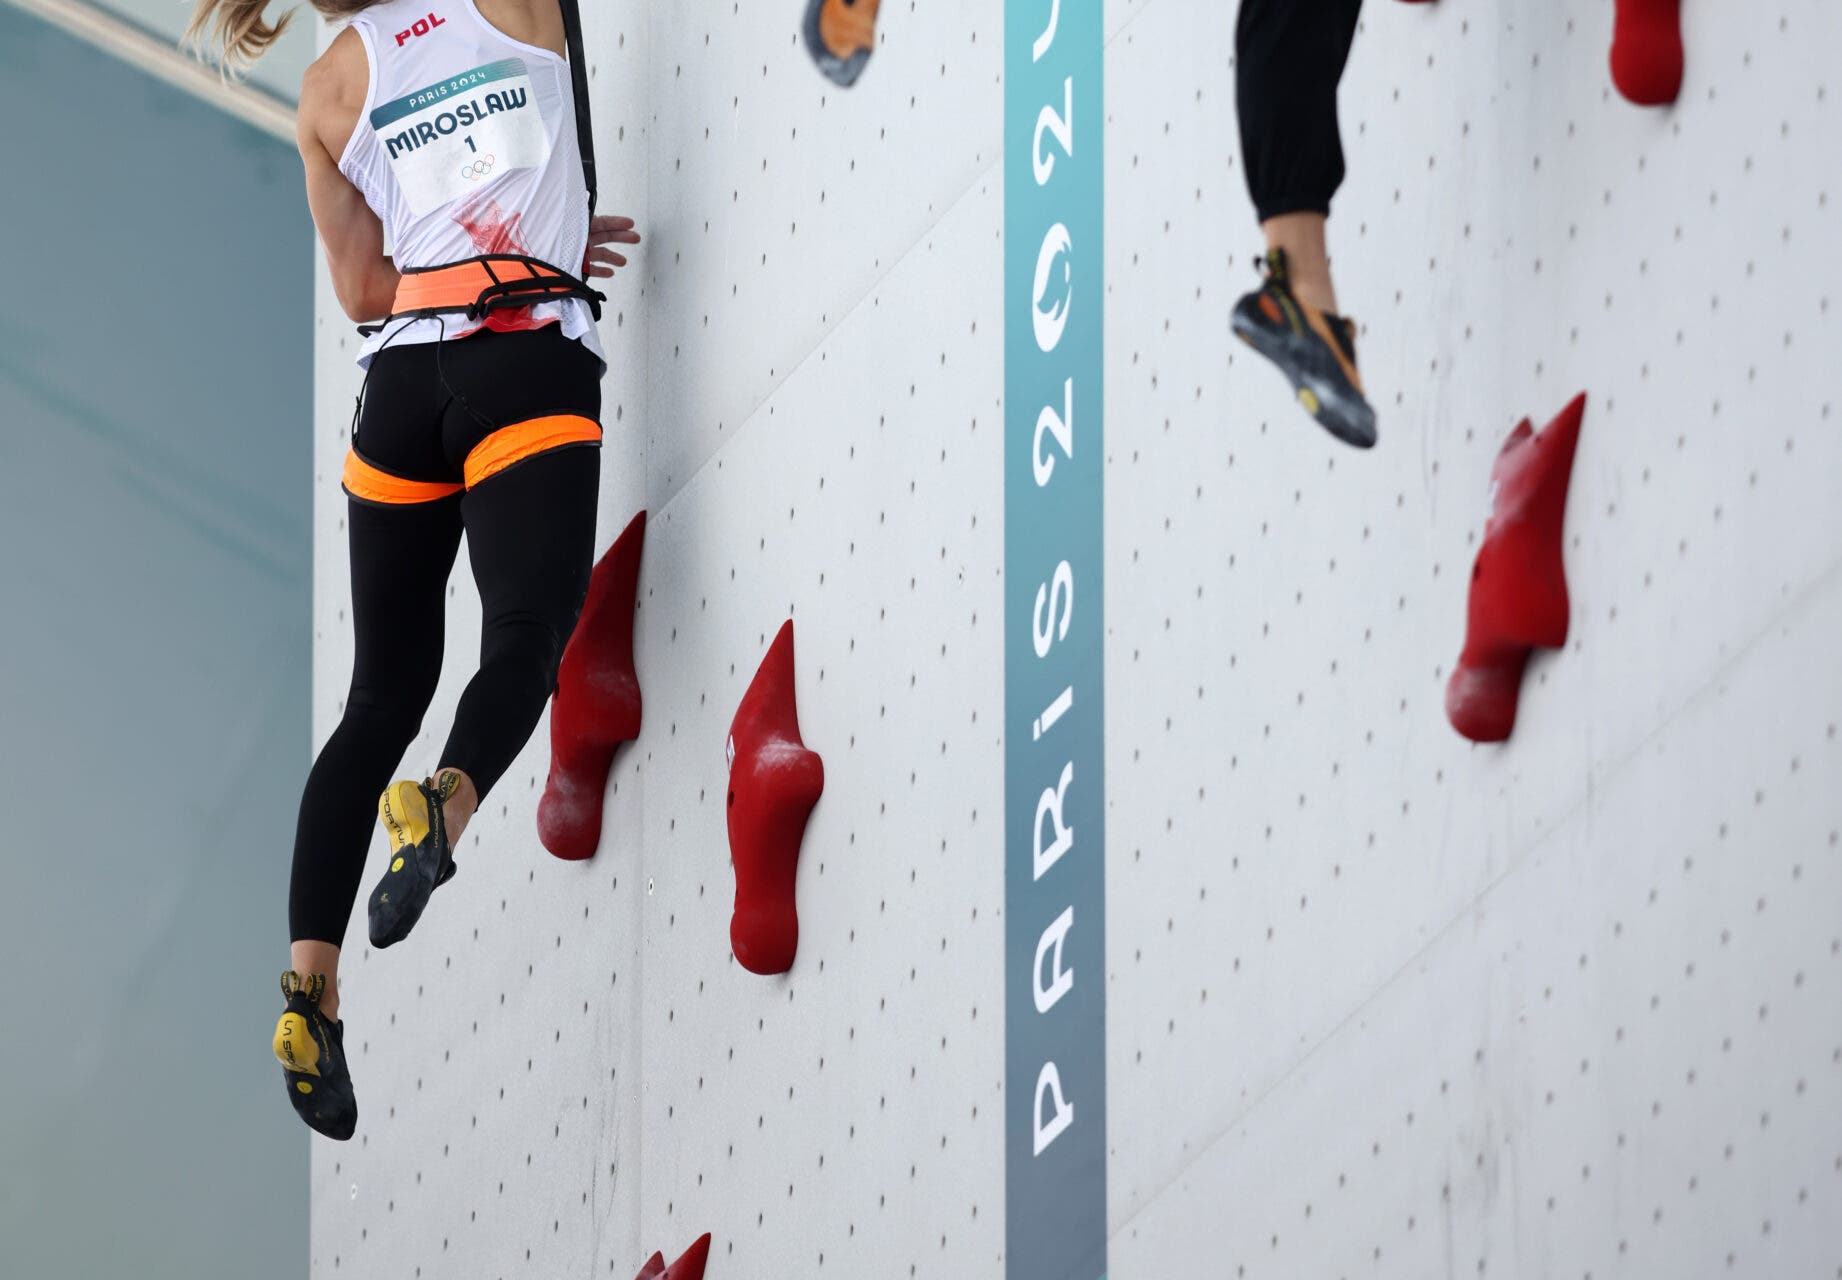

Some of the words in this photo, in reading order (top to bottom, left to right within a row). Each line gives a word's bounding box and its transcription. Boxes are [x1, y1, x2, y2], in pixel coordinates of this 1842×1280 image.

[394, 12, 446, 47] POL
[409, 86, 448, 108] PARIS
[450, 71, 486, 91] 2024
[385, 87, 527, 160] MIROSLAW
[464, 135, 477, 154] 1
